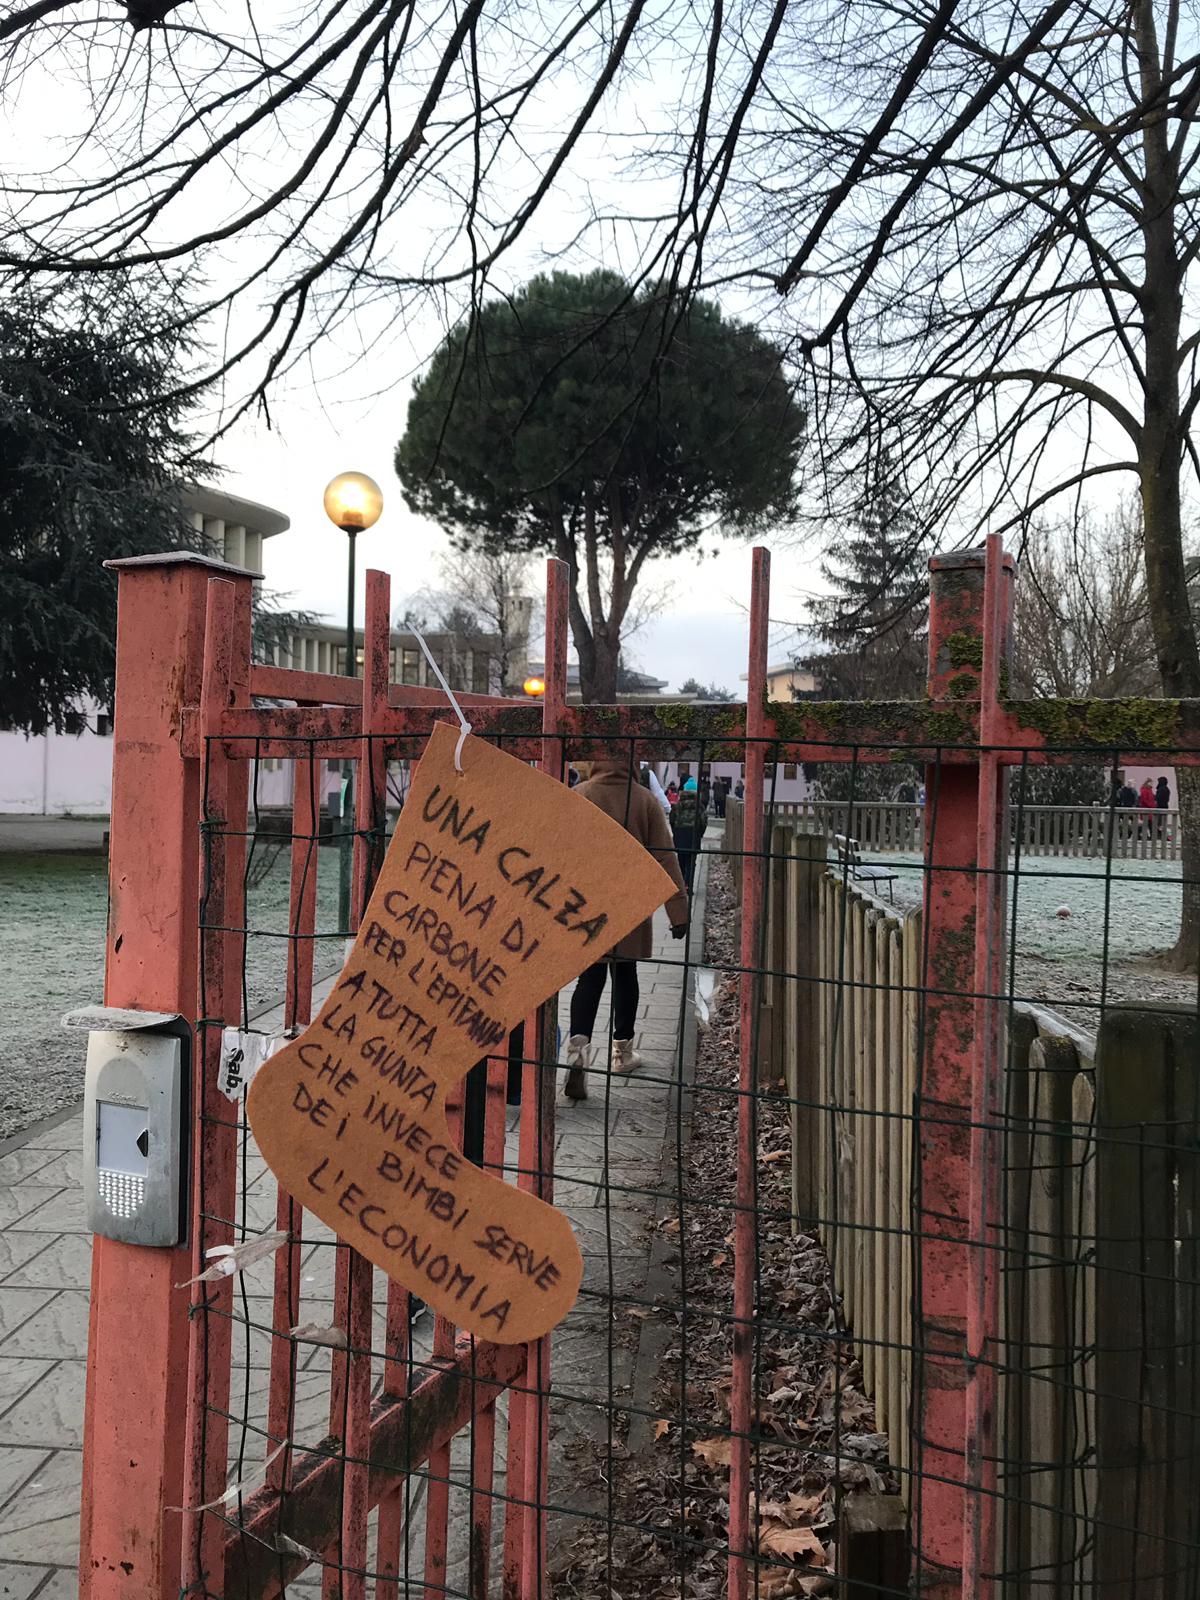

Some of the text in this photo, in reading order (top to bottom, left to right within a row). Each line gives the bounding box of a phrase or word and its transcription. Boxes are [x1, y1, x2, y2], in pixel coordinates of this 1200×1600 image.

[404, 841, 496, 928] PIENA
[422, 785, 607, 946] UNA CALZA
[363, 921, 407, 967] PER
[384, 890, 507, 997] CARBONE
[321, 1003, 439, 1111] LA GIUNTA
[339, 970, 437, 1056] A TUTTA
[297, 1043, 463, 1181] CHE INVECE
[307, 1157, 511, 1331] L'ECONOMIA
[473, 1225, 561, 1292] SERVE
